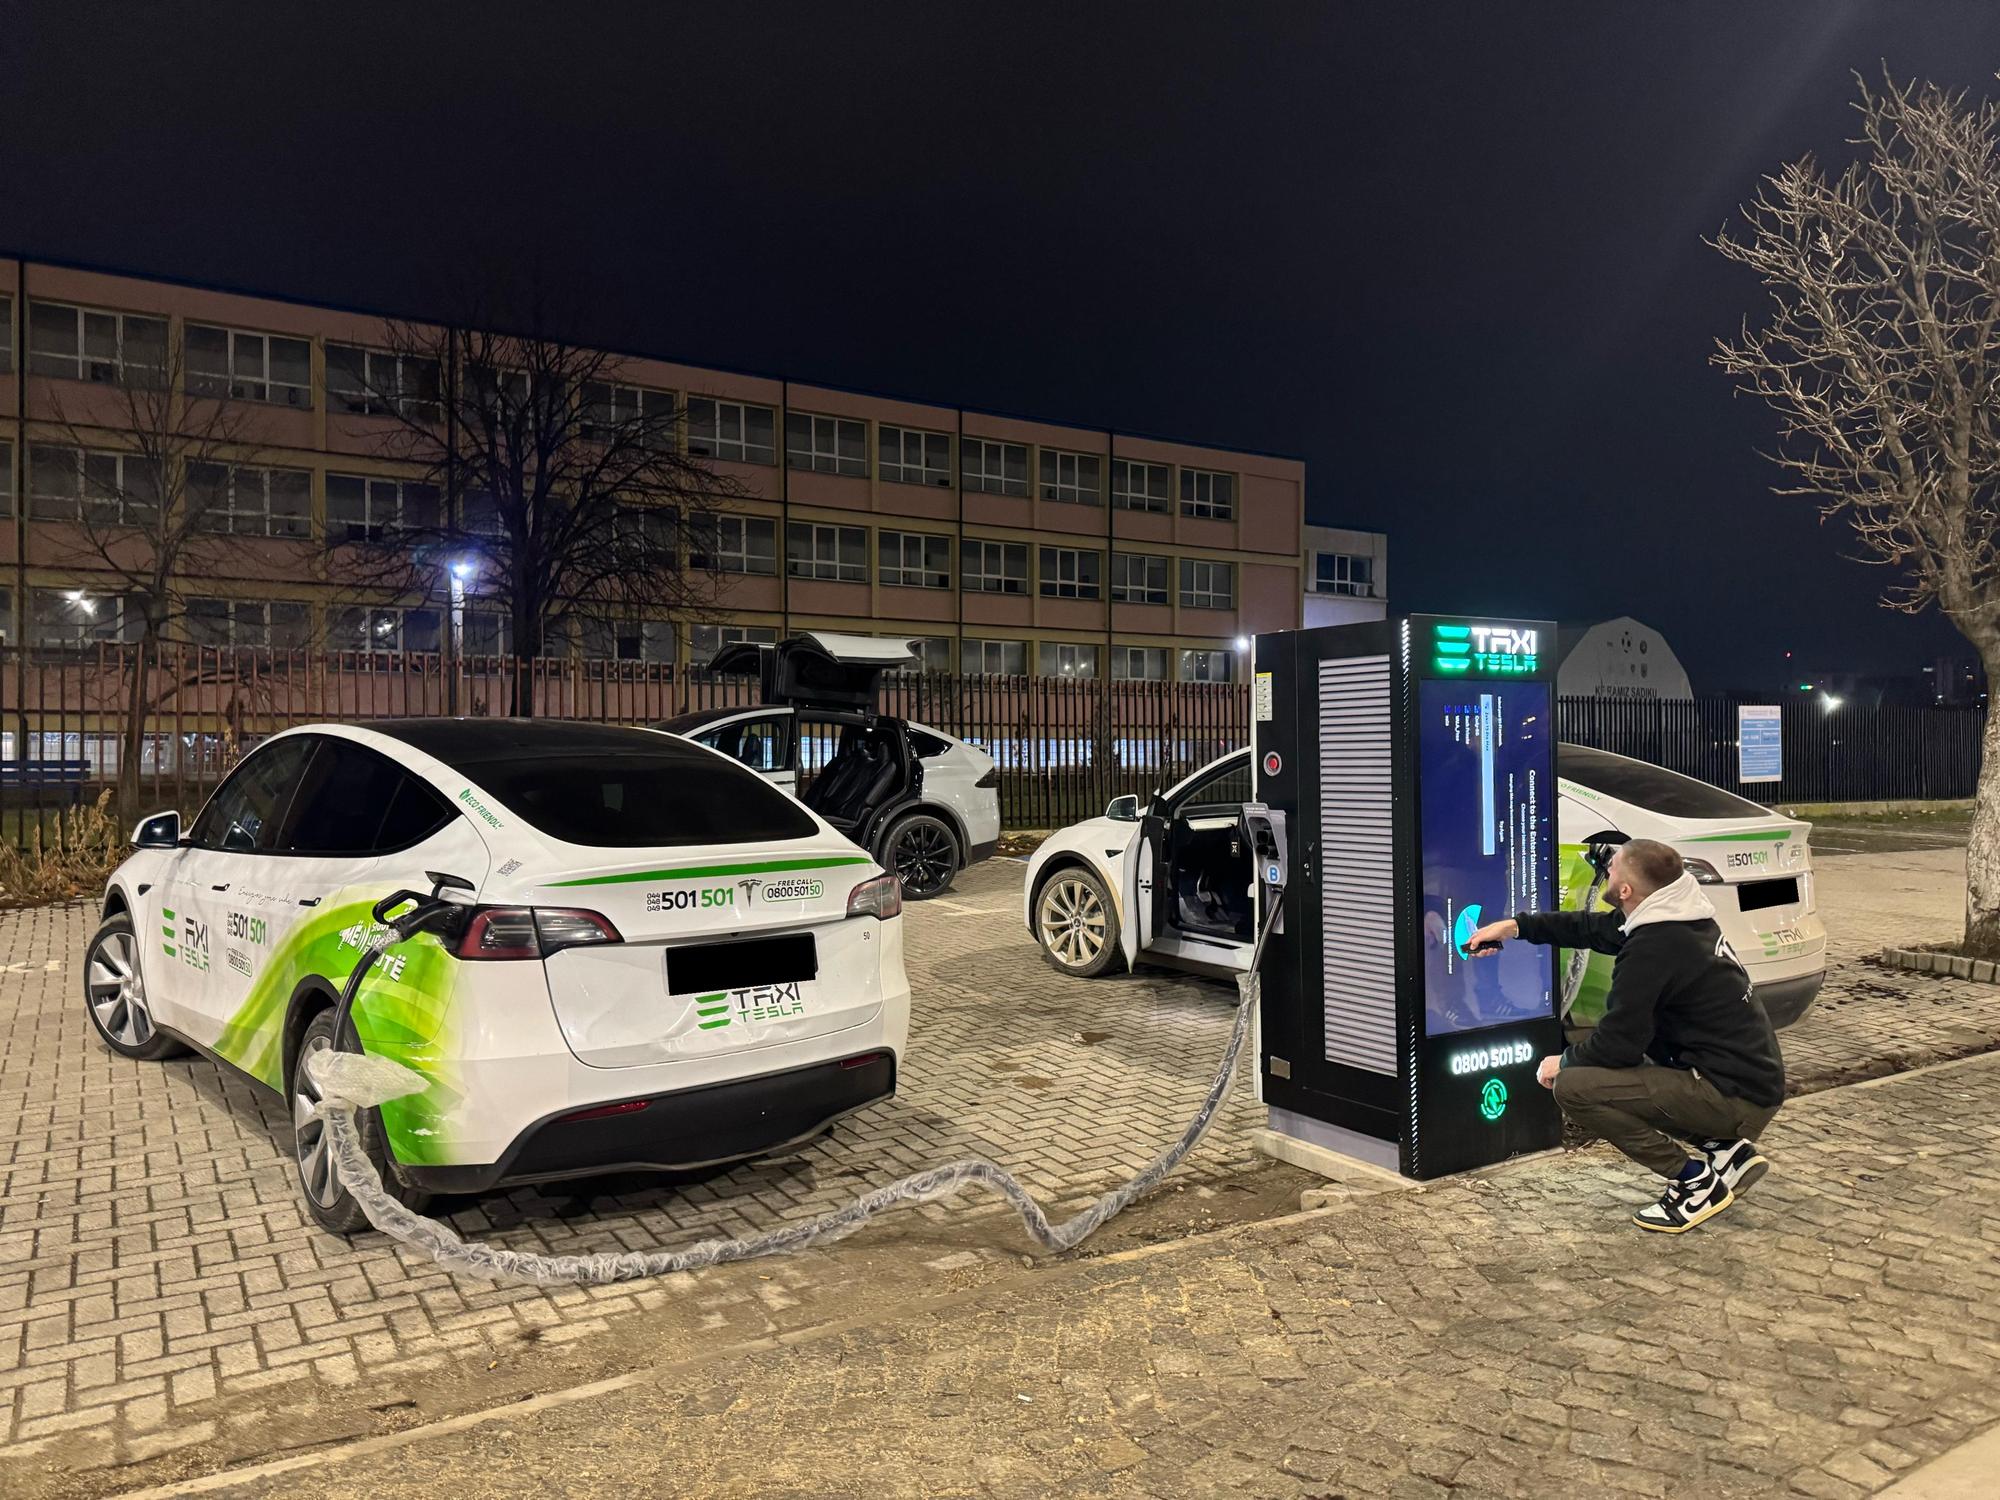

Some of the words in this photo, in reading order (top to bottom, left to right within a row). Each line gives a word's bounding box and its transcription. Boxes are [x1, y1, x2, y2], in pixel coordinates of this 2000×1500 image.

[1471, 627, 1537, 654] TAXI
[1474, 653, 1537, 672] TESLA
[1607, 685, 1630, 697] RAMIZ
[1631, 686, 1658, 698] SADIKU
[465, 796, 480, 809] ECO
[475, 805, 505, 830] FRIENDLY
[1530, 806, 1536, 814] to
[1735, 853, 1753, 866] 501
[1753, 851, 1768, 864] 501
[1269, 867, 1278, 881] B
[661, 890, 696, 910] 501
[701, 888, 733, 907] 501
[233, 912, 248, 940] 501
[249, 917, 266, 946] 501
[863, 931, 870, 940] 50
[1773, 928, 1803, 944] TAXI
[731, 982, 801, 1009] TAXI
[737, 1002, 804, 1022] TESLA
[1452, 1050, 1489, 1075] 0800
[1490, 1046, 1513, 1068] 501
[1514, 1042, 1533, 1063] 50
